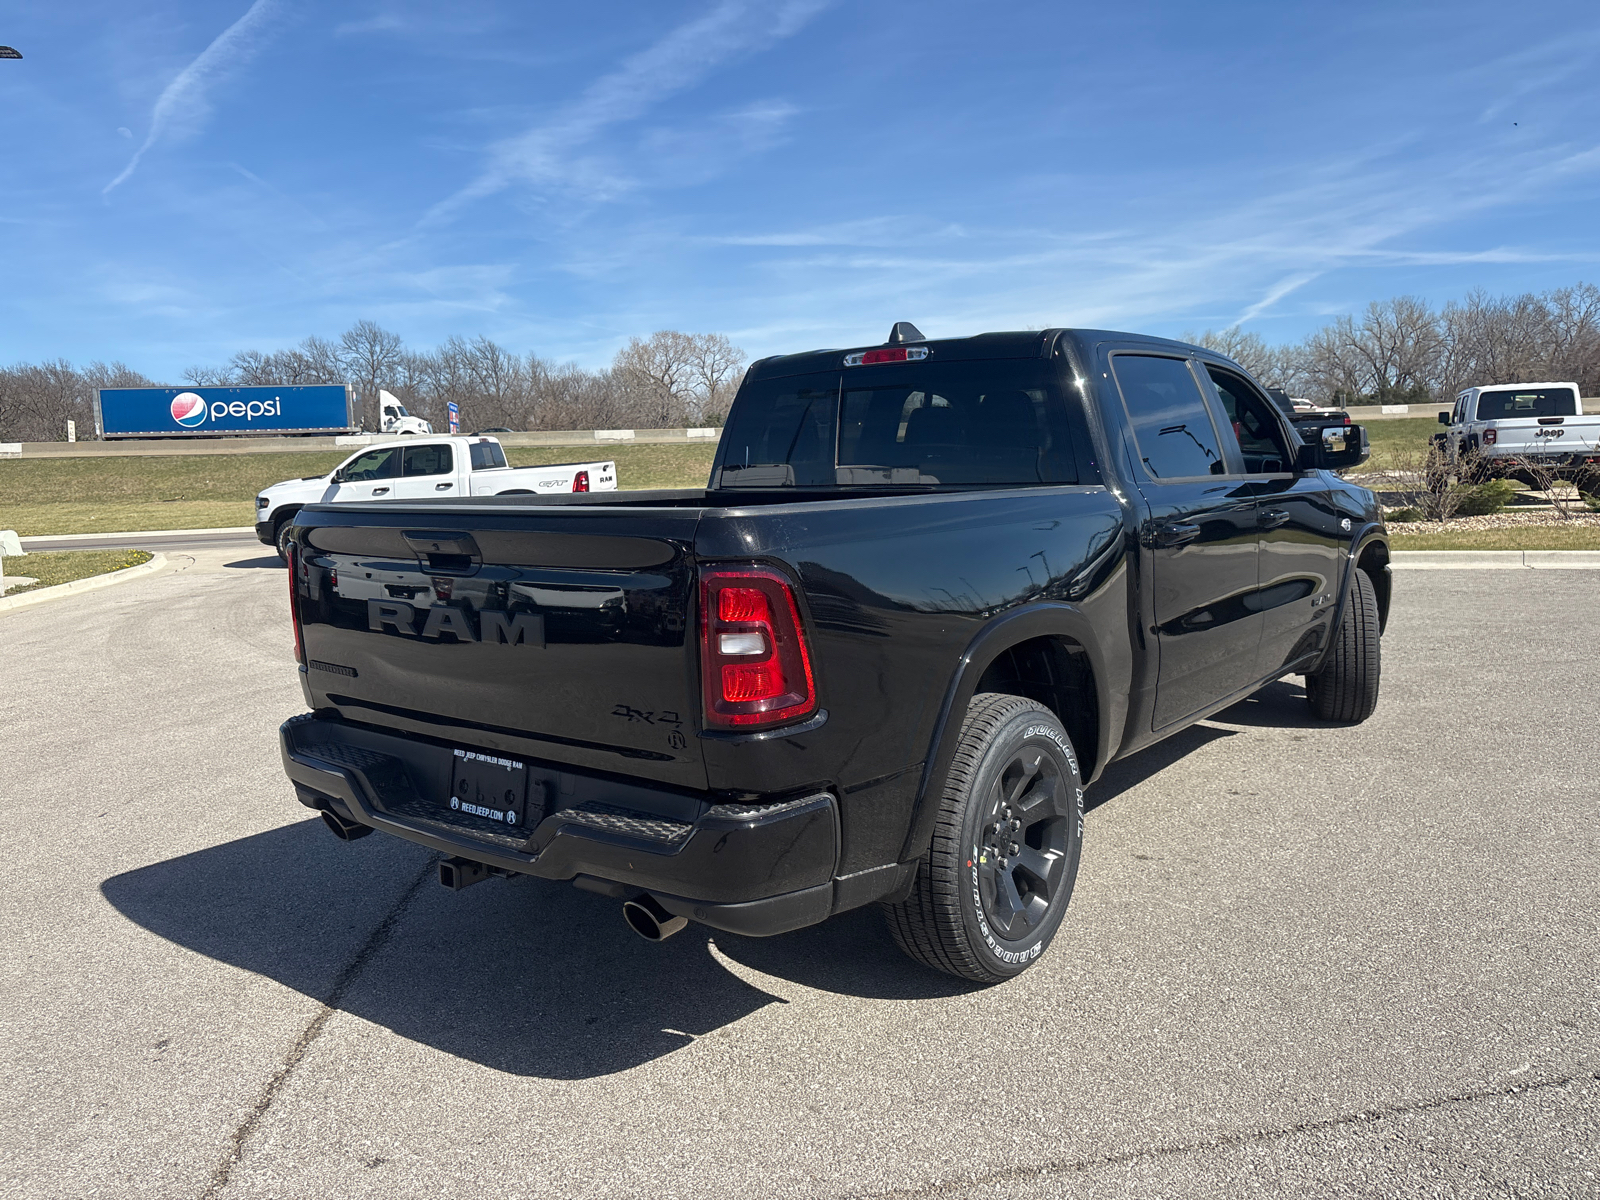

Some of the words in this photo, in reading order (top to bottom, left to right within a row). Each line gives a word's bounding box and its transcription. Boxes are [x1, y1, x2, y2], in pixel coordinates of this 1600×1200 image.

[211, 396, 281, 422] pepsi
[1535, 428, 1564, 438] Jeep
[367, 598, 546, 649] RAM
[454, 749, 465, 757] REED
[466, 751, 475, 759] JEEP
[477, 754, 497, 764] CHRYSLER
[498, 757, 512, 767] DODGE
[513, 761, 522, 769] RAM
[1023, 725, 1078, 775] DUELER
[462, 803, 503, 821] REEDJEEP.COM
[972, 844, 1042, 964] BRIDGESTONE
